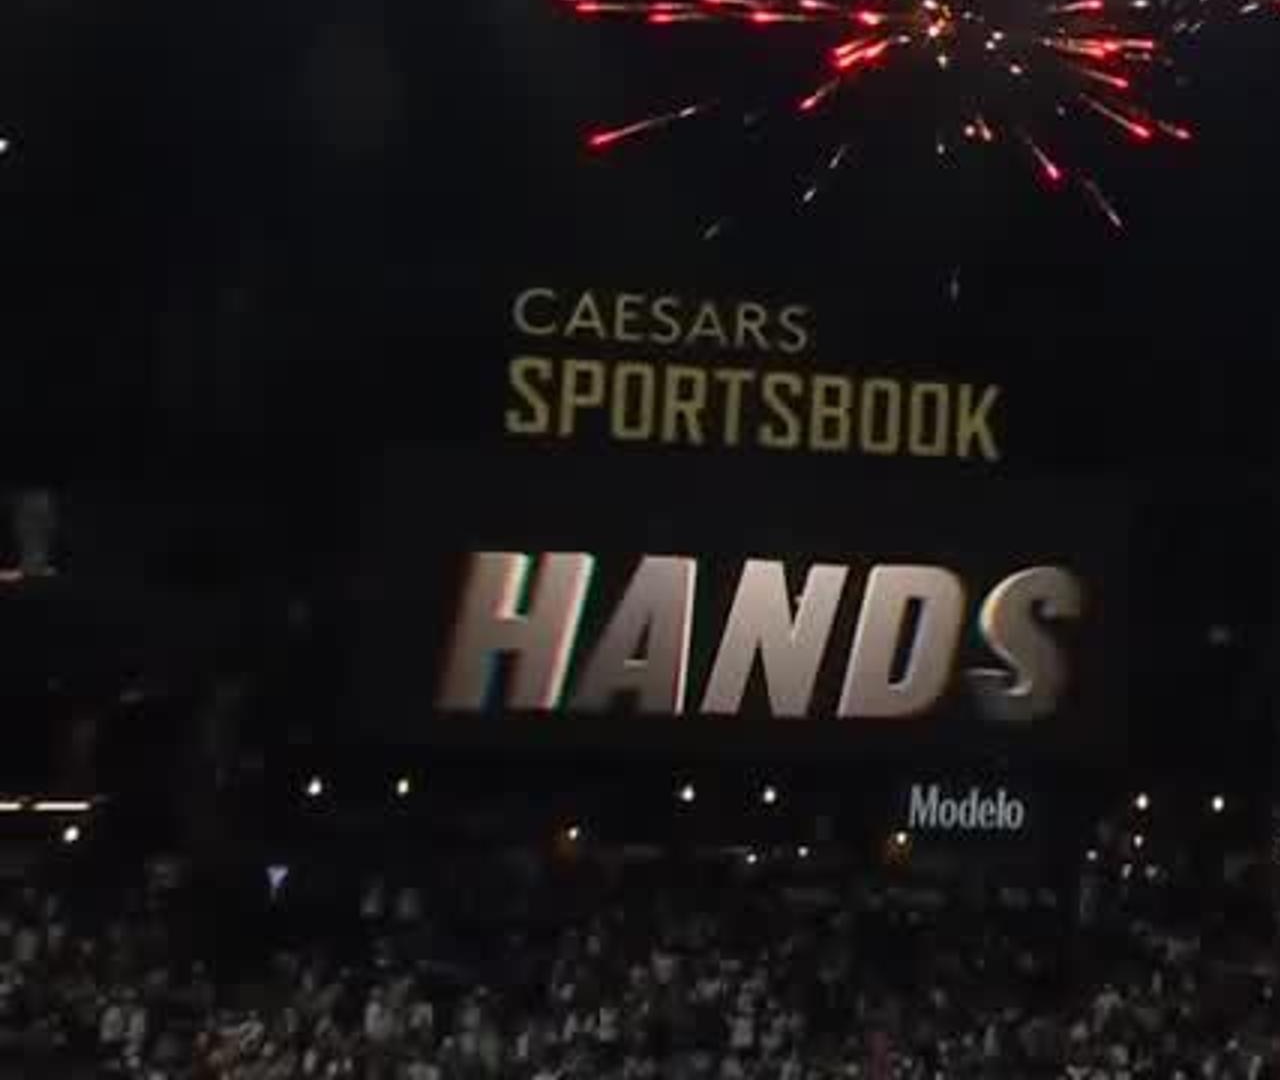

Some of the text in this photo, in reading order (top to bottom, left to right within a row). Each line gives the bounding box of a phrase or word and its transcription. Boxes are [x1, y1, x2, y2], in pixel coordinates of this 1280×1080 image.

[512, 286, 809, 353] CAESARS
[505, 356, 1001, 461] SPORTSBOOK
[434, 550, 1086, 722] HANDS
[908, 783, 1025, 831] Modelo
